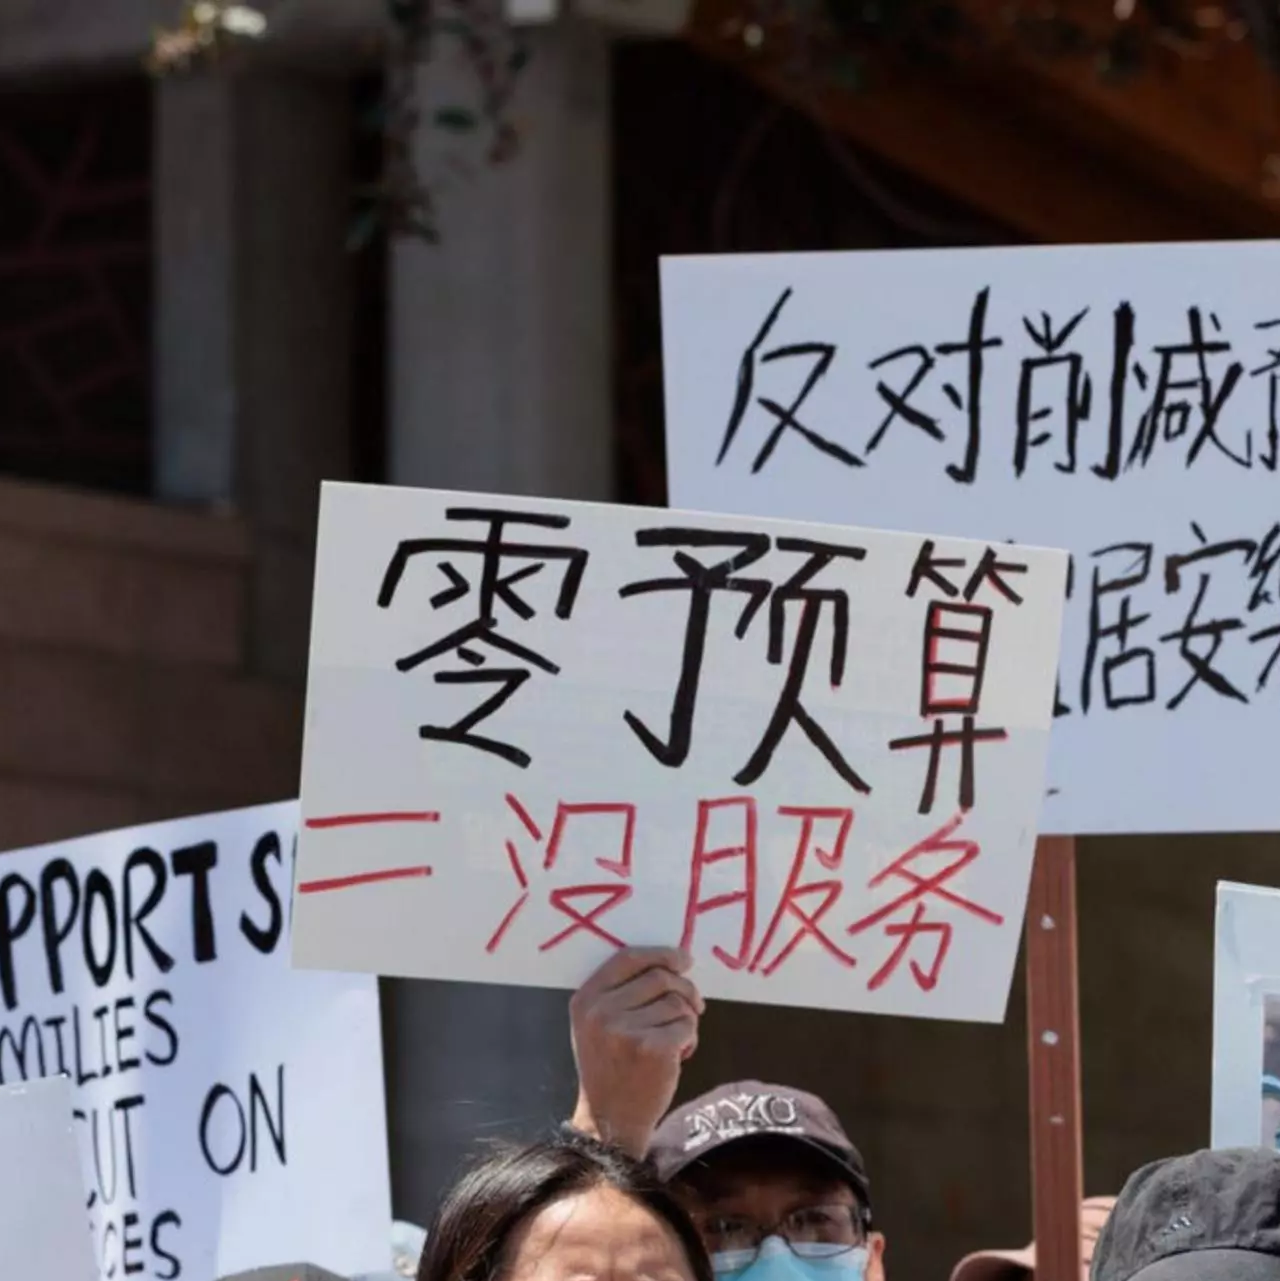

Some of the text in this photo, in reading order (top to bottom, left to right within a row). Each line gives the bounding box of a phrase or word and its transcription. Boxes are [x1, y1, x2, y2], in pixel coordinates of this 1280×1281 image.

[377, 507, 1029, 814] 零预算
[239, 830, 297, 954] S
[72, 1063, 287, 1210] UT ON
